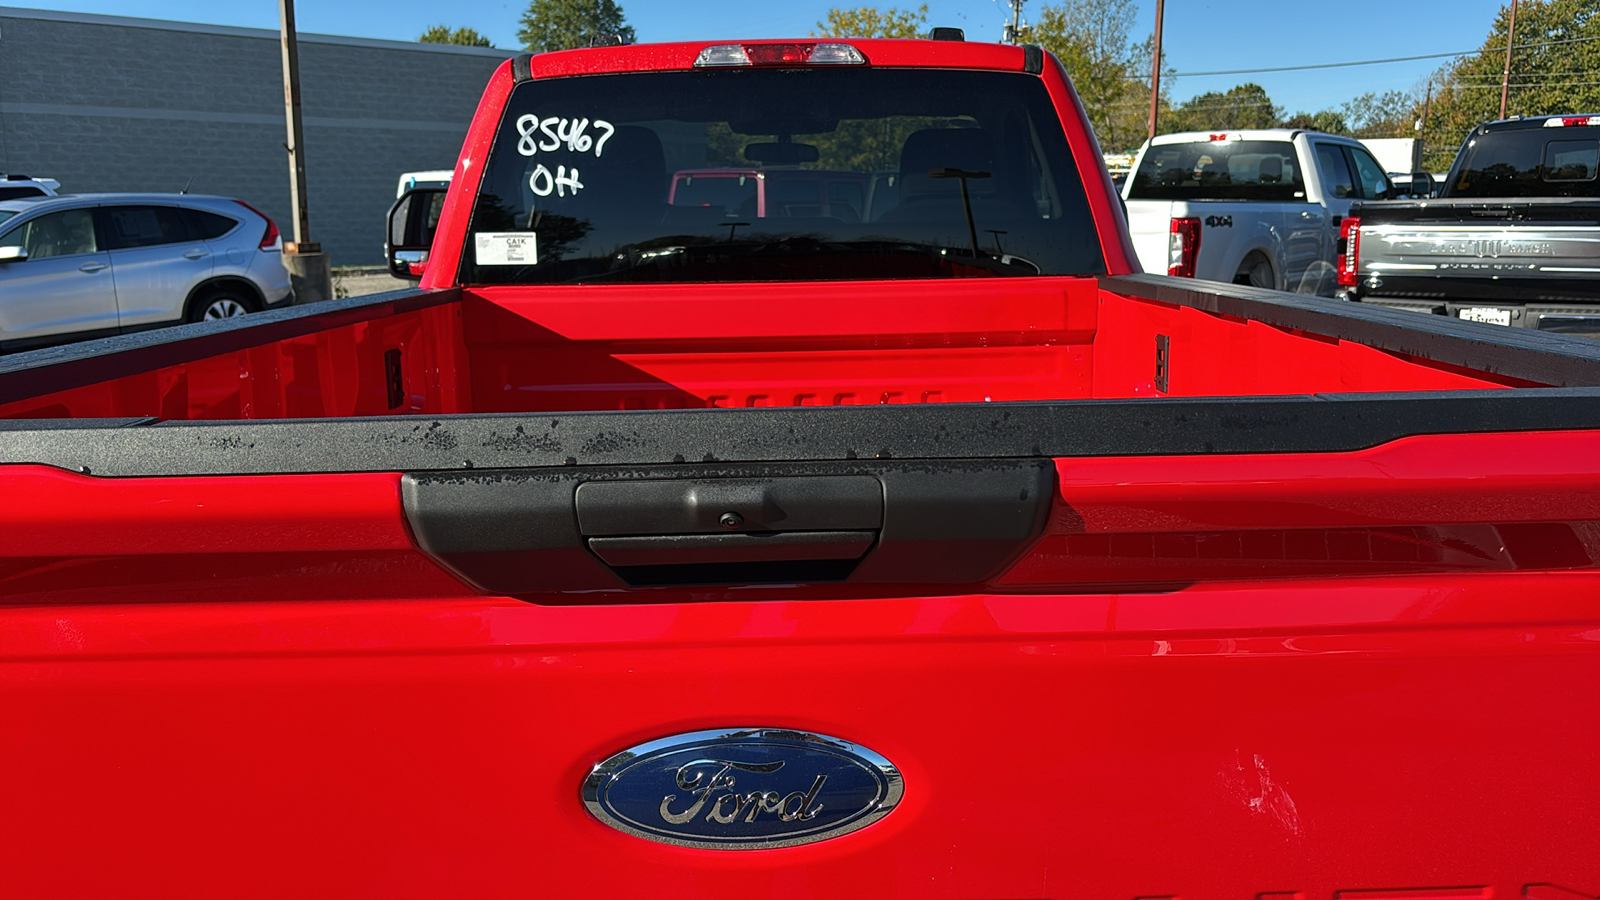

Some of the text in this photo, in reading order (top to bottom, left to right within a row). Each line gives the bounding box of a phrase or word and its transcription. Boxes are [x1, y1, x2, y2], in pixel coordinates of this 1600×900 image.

[516, 113, 615, 157] 85467
[529, 164, 584, 198] OH
[659, 759, 827, 825] Ford
